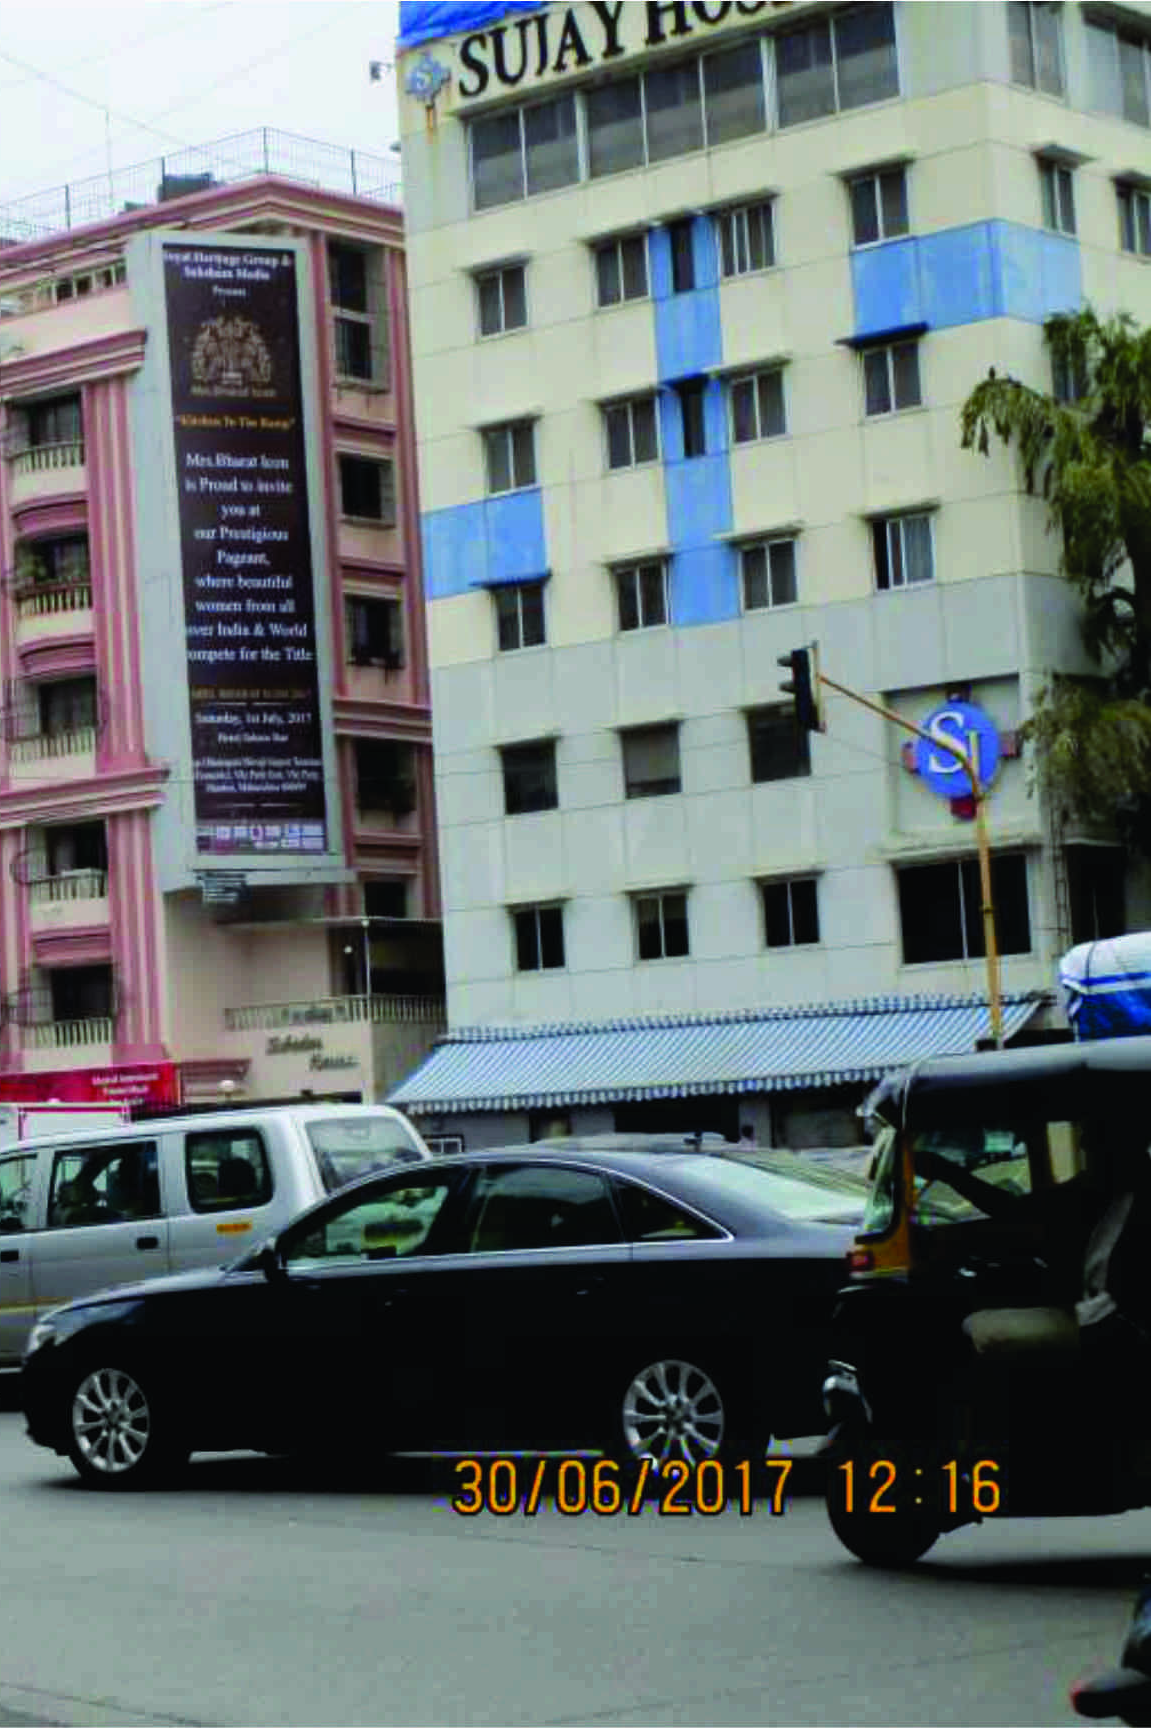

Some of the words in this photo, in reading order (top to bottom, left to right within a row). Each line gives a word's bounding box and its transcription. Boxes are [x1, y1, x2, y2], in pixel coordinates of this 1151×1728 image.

[458, 2, 625, 97] SUJAY
[200, 477, 238, 493] Proud
[240, 480, 253, 493] to
[256, 478, 292, 494] invite
[220, 504, 247, 520] you
[193, 529, 217, 540] our
[219, 526, 289, 544] Prestigious
[195, 574, 235, 589] where
[237, 574, 293, 590] beautiful
[195, 601, 242, 613] women
[245, 599, 276, 613] from
[279, 599, 295, 613] all
[217, 621, 251, 637] India
[253, 622, 265, 637] &
[269, 622, 307, 638] World
[240, 647, 258, 661] for
[260, 647, 281, 661] the
